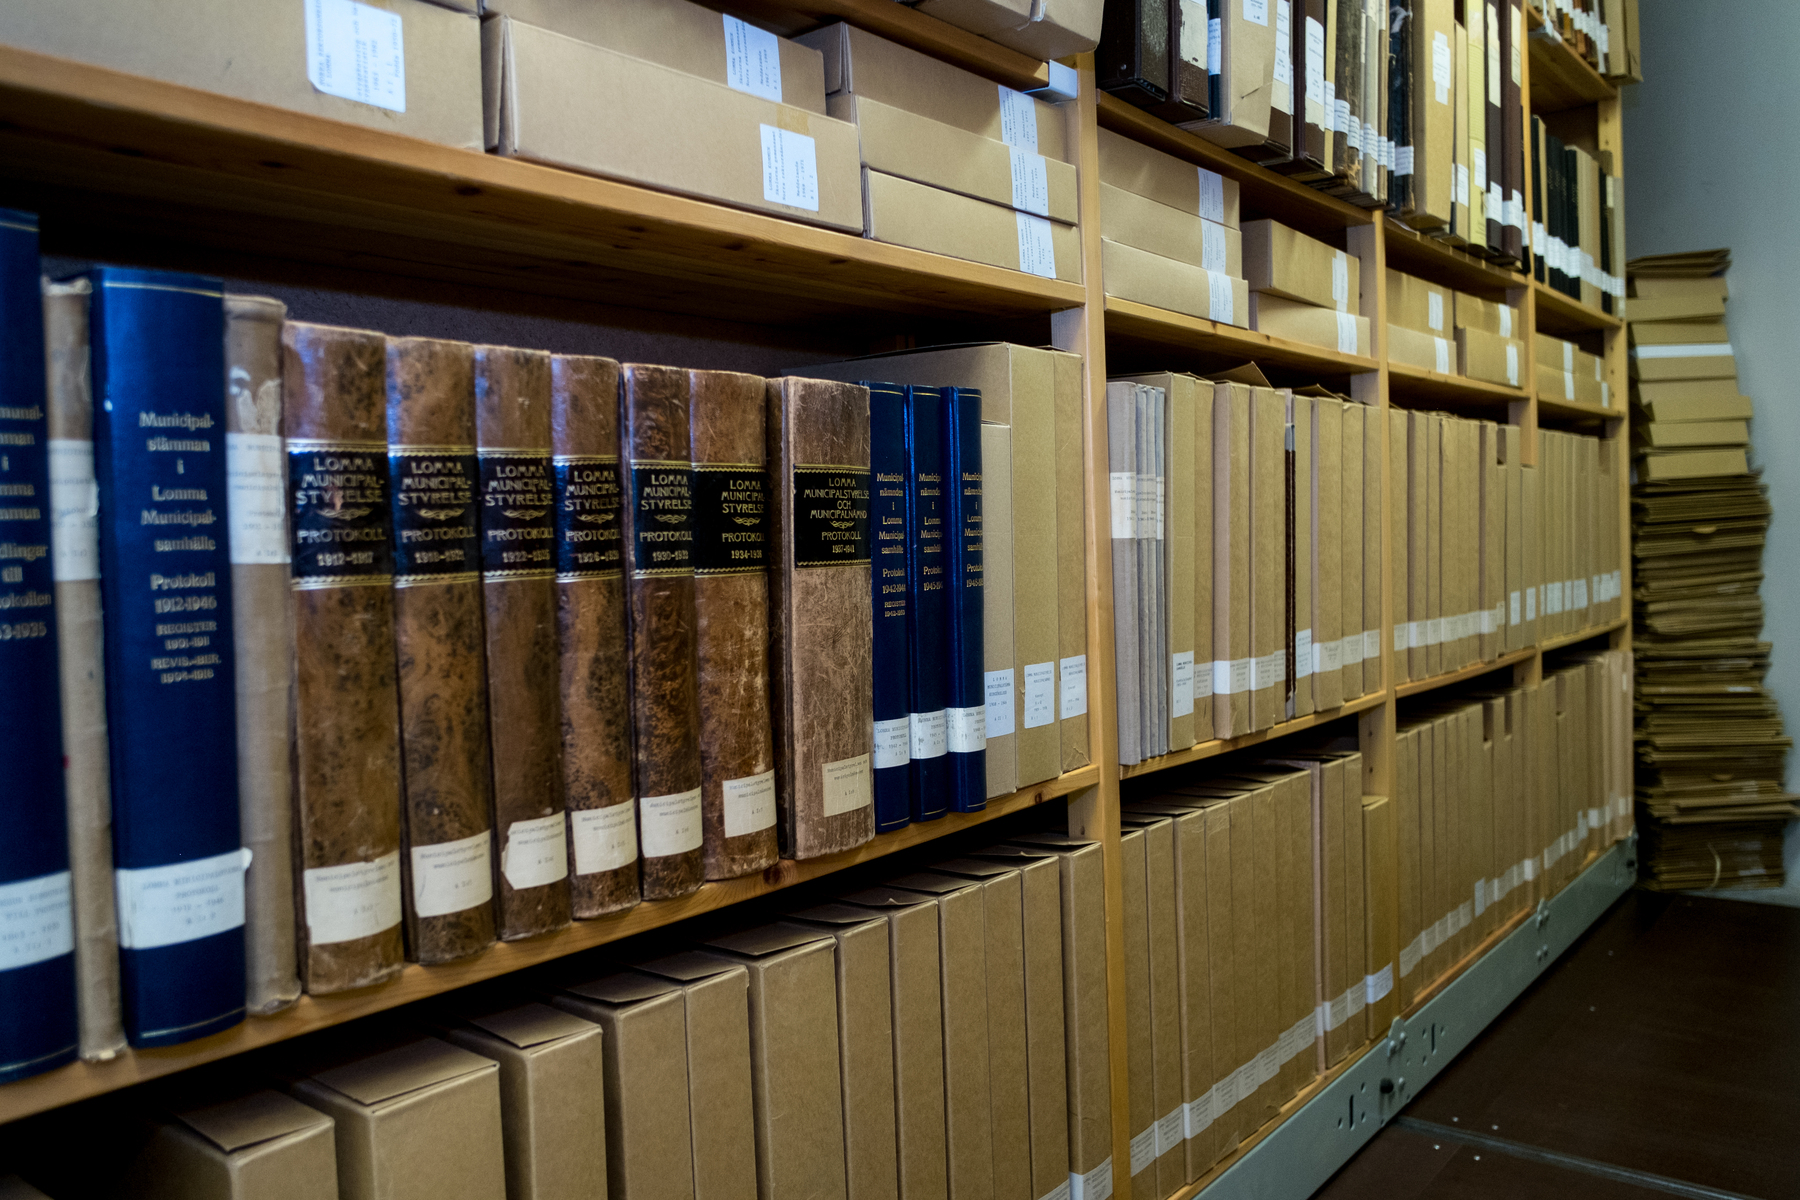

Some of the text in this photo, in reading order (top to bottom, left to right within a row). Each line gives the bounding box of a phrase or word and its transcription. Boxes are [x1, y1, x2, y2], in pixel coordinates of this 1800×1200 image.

[139, 411, 215, 431] Municipal-
[146, 437, 210, 452] stämman
[176, 458, 185, 475] i
[313, 457, 375, 471] LOMMA
[411, 461, 464, 474] LOMMA
[496, 465, 546, 478] LOMMA
[574, 470, 616, 482] LOMMA
[301, 474, 385, 488] MUNICIPAL-
[651, 474, 688, 485] LOMMA
[730, 480, 761, 490] LOMMA
[829, 478, 856, 487] LOMMA
[151, 485, 208, 502] Lomma
[398, 491, 472, 505] STYRELSE
[643, 487, 692, 497] MUNICIPAL-
[804, 489, 870, 499] MUNICIPALSTYRELSE
[485, 494, 553, 506] STYRELSE
[641, 500, 692, 511] STYRELSE
[837, 500, 852, 509] OCH
[722, 503, 764, 513] STYRELSE
[140, 510, 217, 527] Municipal-
[297, 528, 387, 544] PROTOKOLL
[401, 526, 476, 543] PROTOKOLL
[487, 527, 554, 541] PROTOKOLL
[640, 531, 693, 542] PROTOKOLL
[821, 531, 861, 541] PROTOKOLL
[154, 536, 216, 552] samhälle
[150, 572, 216, 591] Protokoll
[0, 591, 52, 609] okollen
[0, 621, 47, 640] 3-1935
